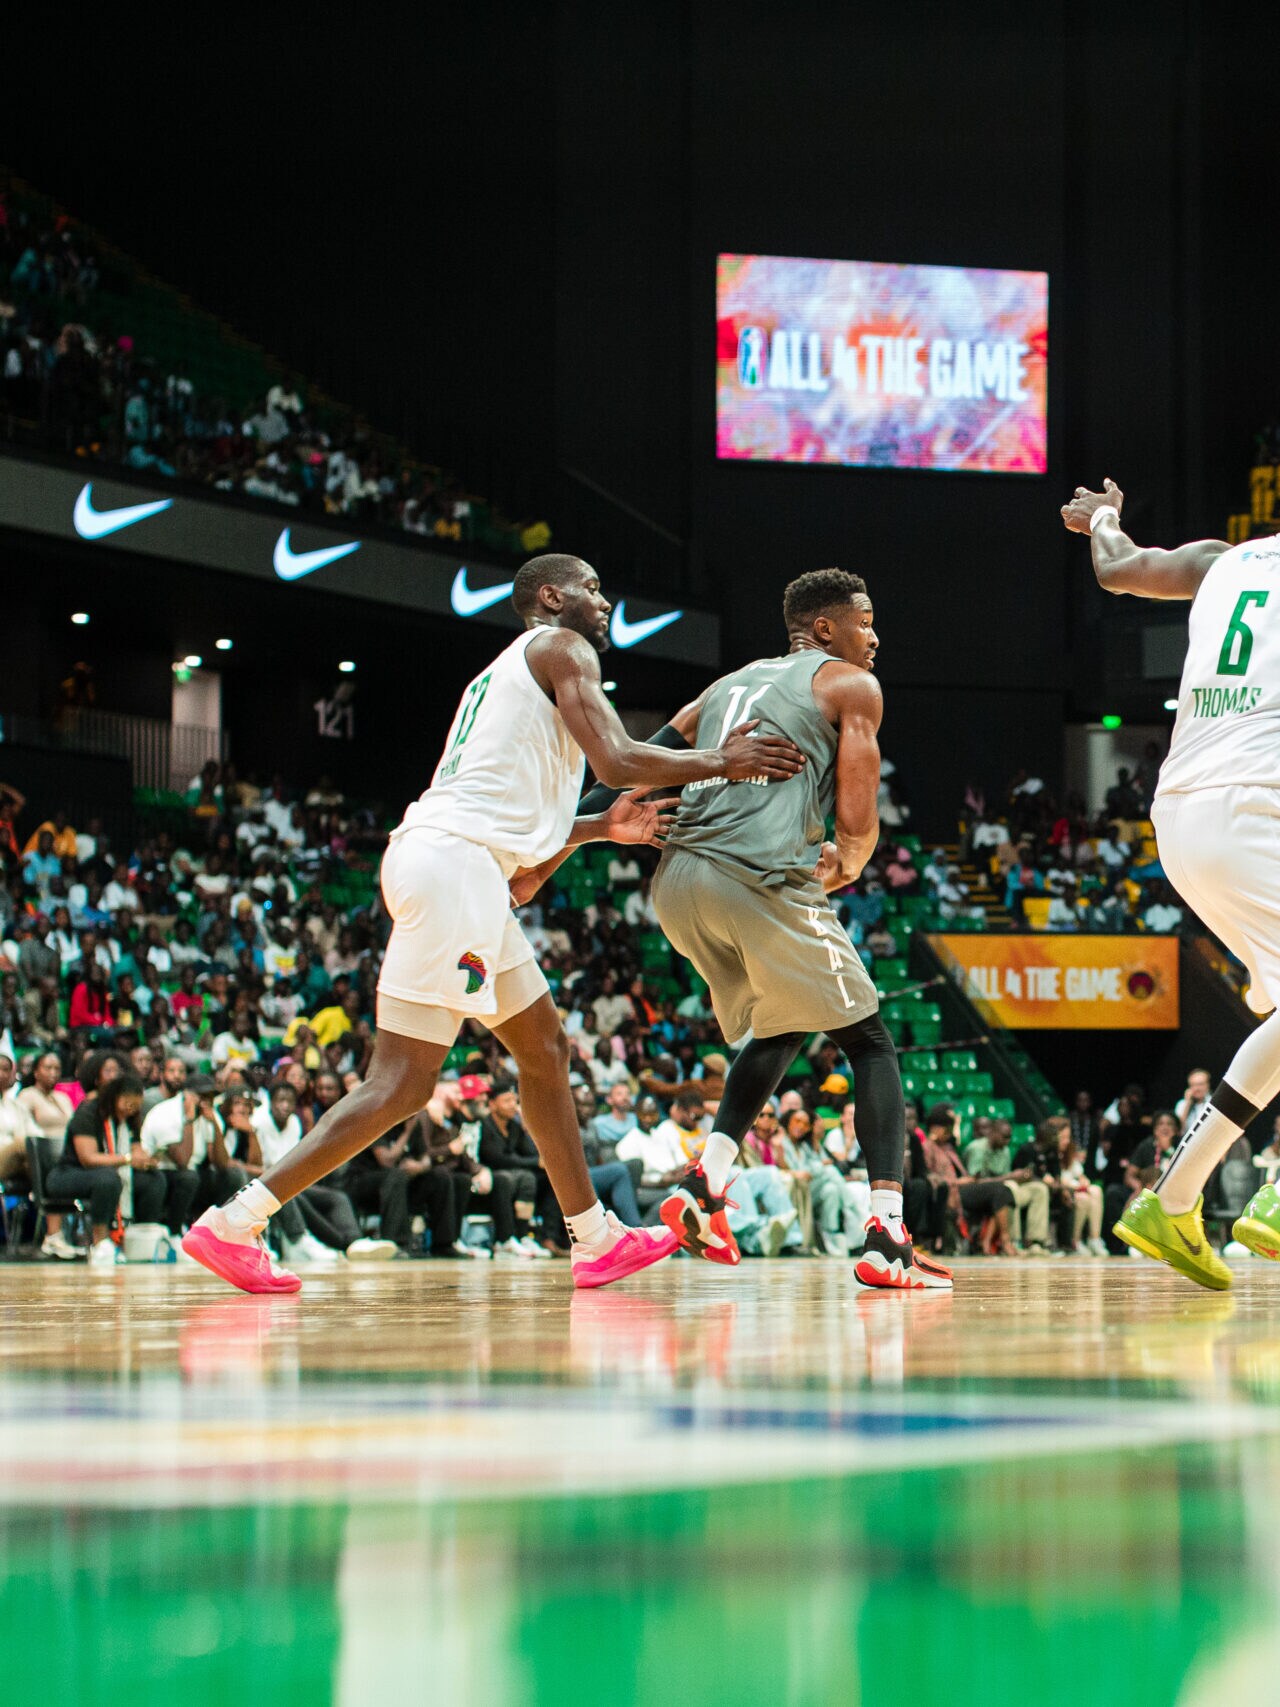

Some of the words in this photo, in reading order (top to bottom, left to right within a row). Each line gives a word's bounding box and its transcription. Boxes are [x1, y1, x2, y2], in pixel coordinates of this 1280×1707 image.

[768, 329, 828, 393] ALL
[860, 335, 924, 397] THE
[928, 339, 1029, 402] GAME
[1216, 590, 1270, 676] 6
[313, 698, 354, 740] 121
[1191, 686, 1262, 718] THOMAS
[967, 966, 1003, 1000] ALL
[1024, 966, 1061, 1001] THE
[1064, 966, 1123, 1001] GAME
